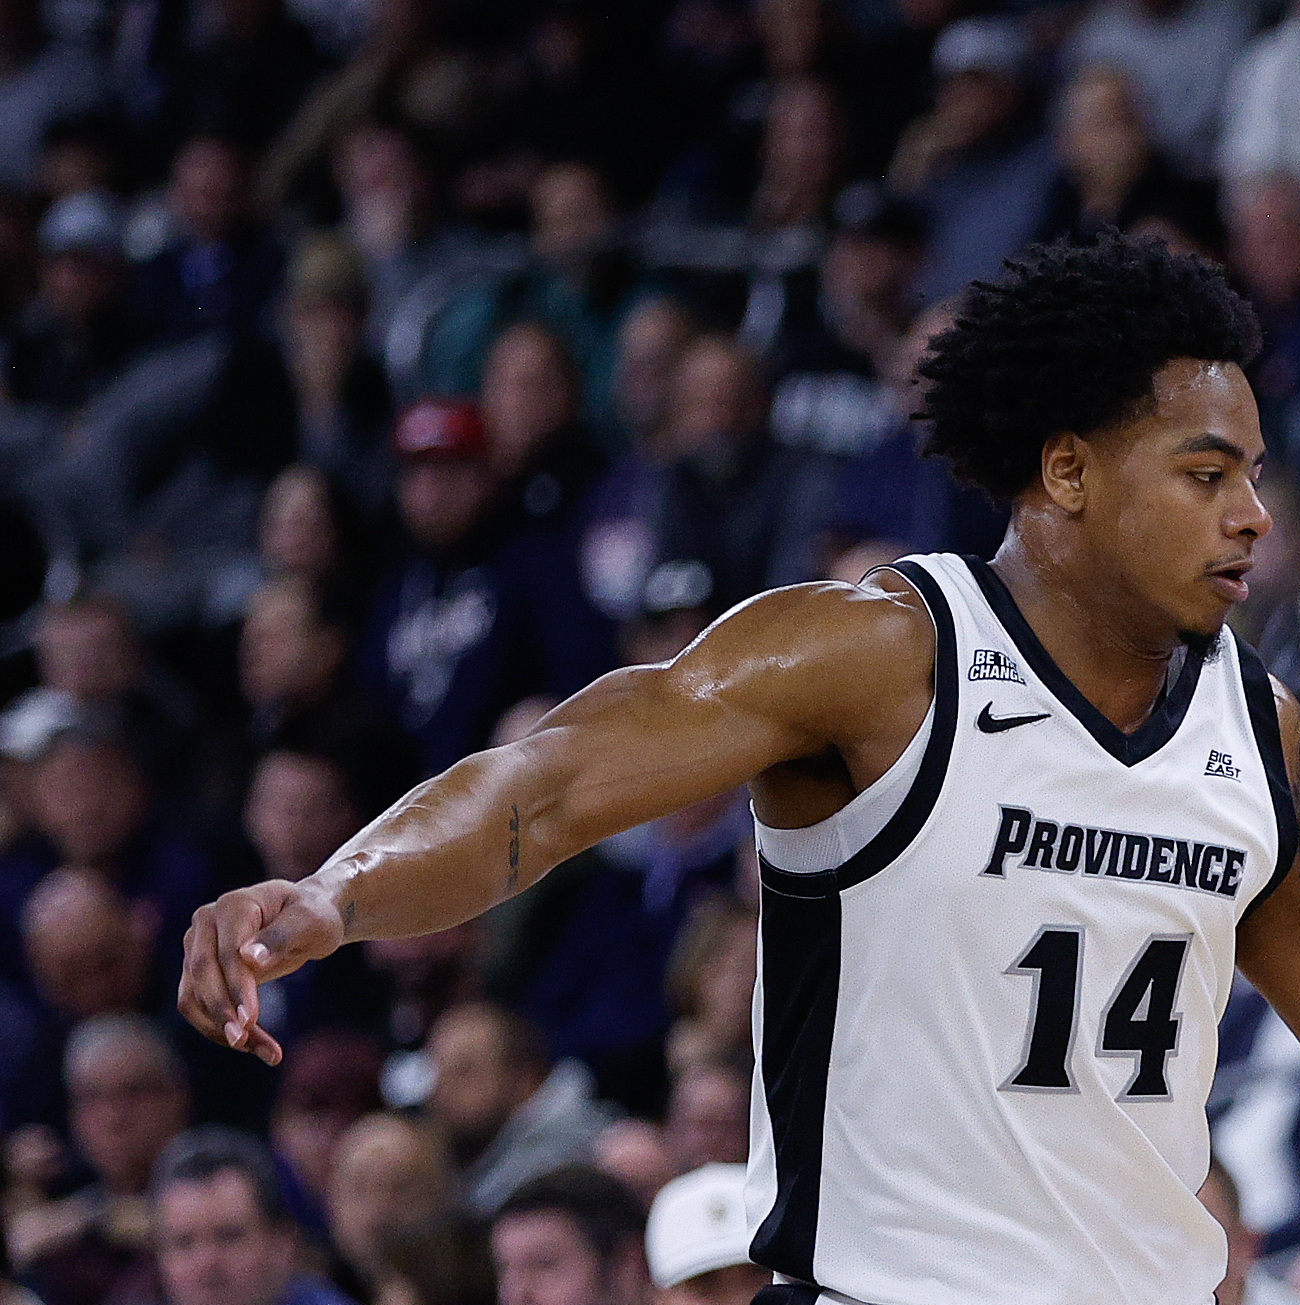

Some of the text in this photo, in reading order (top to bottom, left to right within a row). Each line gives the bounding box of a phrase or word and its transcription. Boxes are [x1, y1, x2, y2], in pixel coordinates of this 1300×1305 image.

[974, 650, 996, 665] BE
[1208, 749, 1232, 766] BIG
[1206, 761, 1241, 778] EAST
[980, 804, 1248, 900] PROVIDENCE
[998, 923, 1194, 1103] 14
